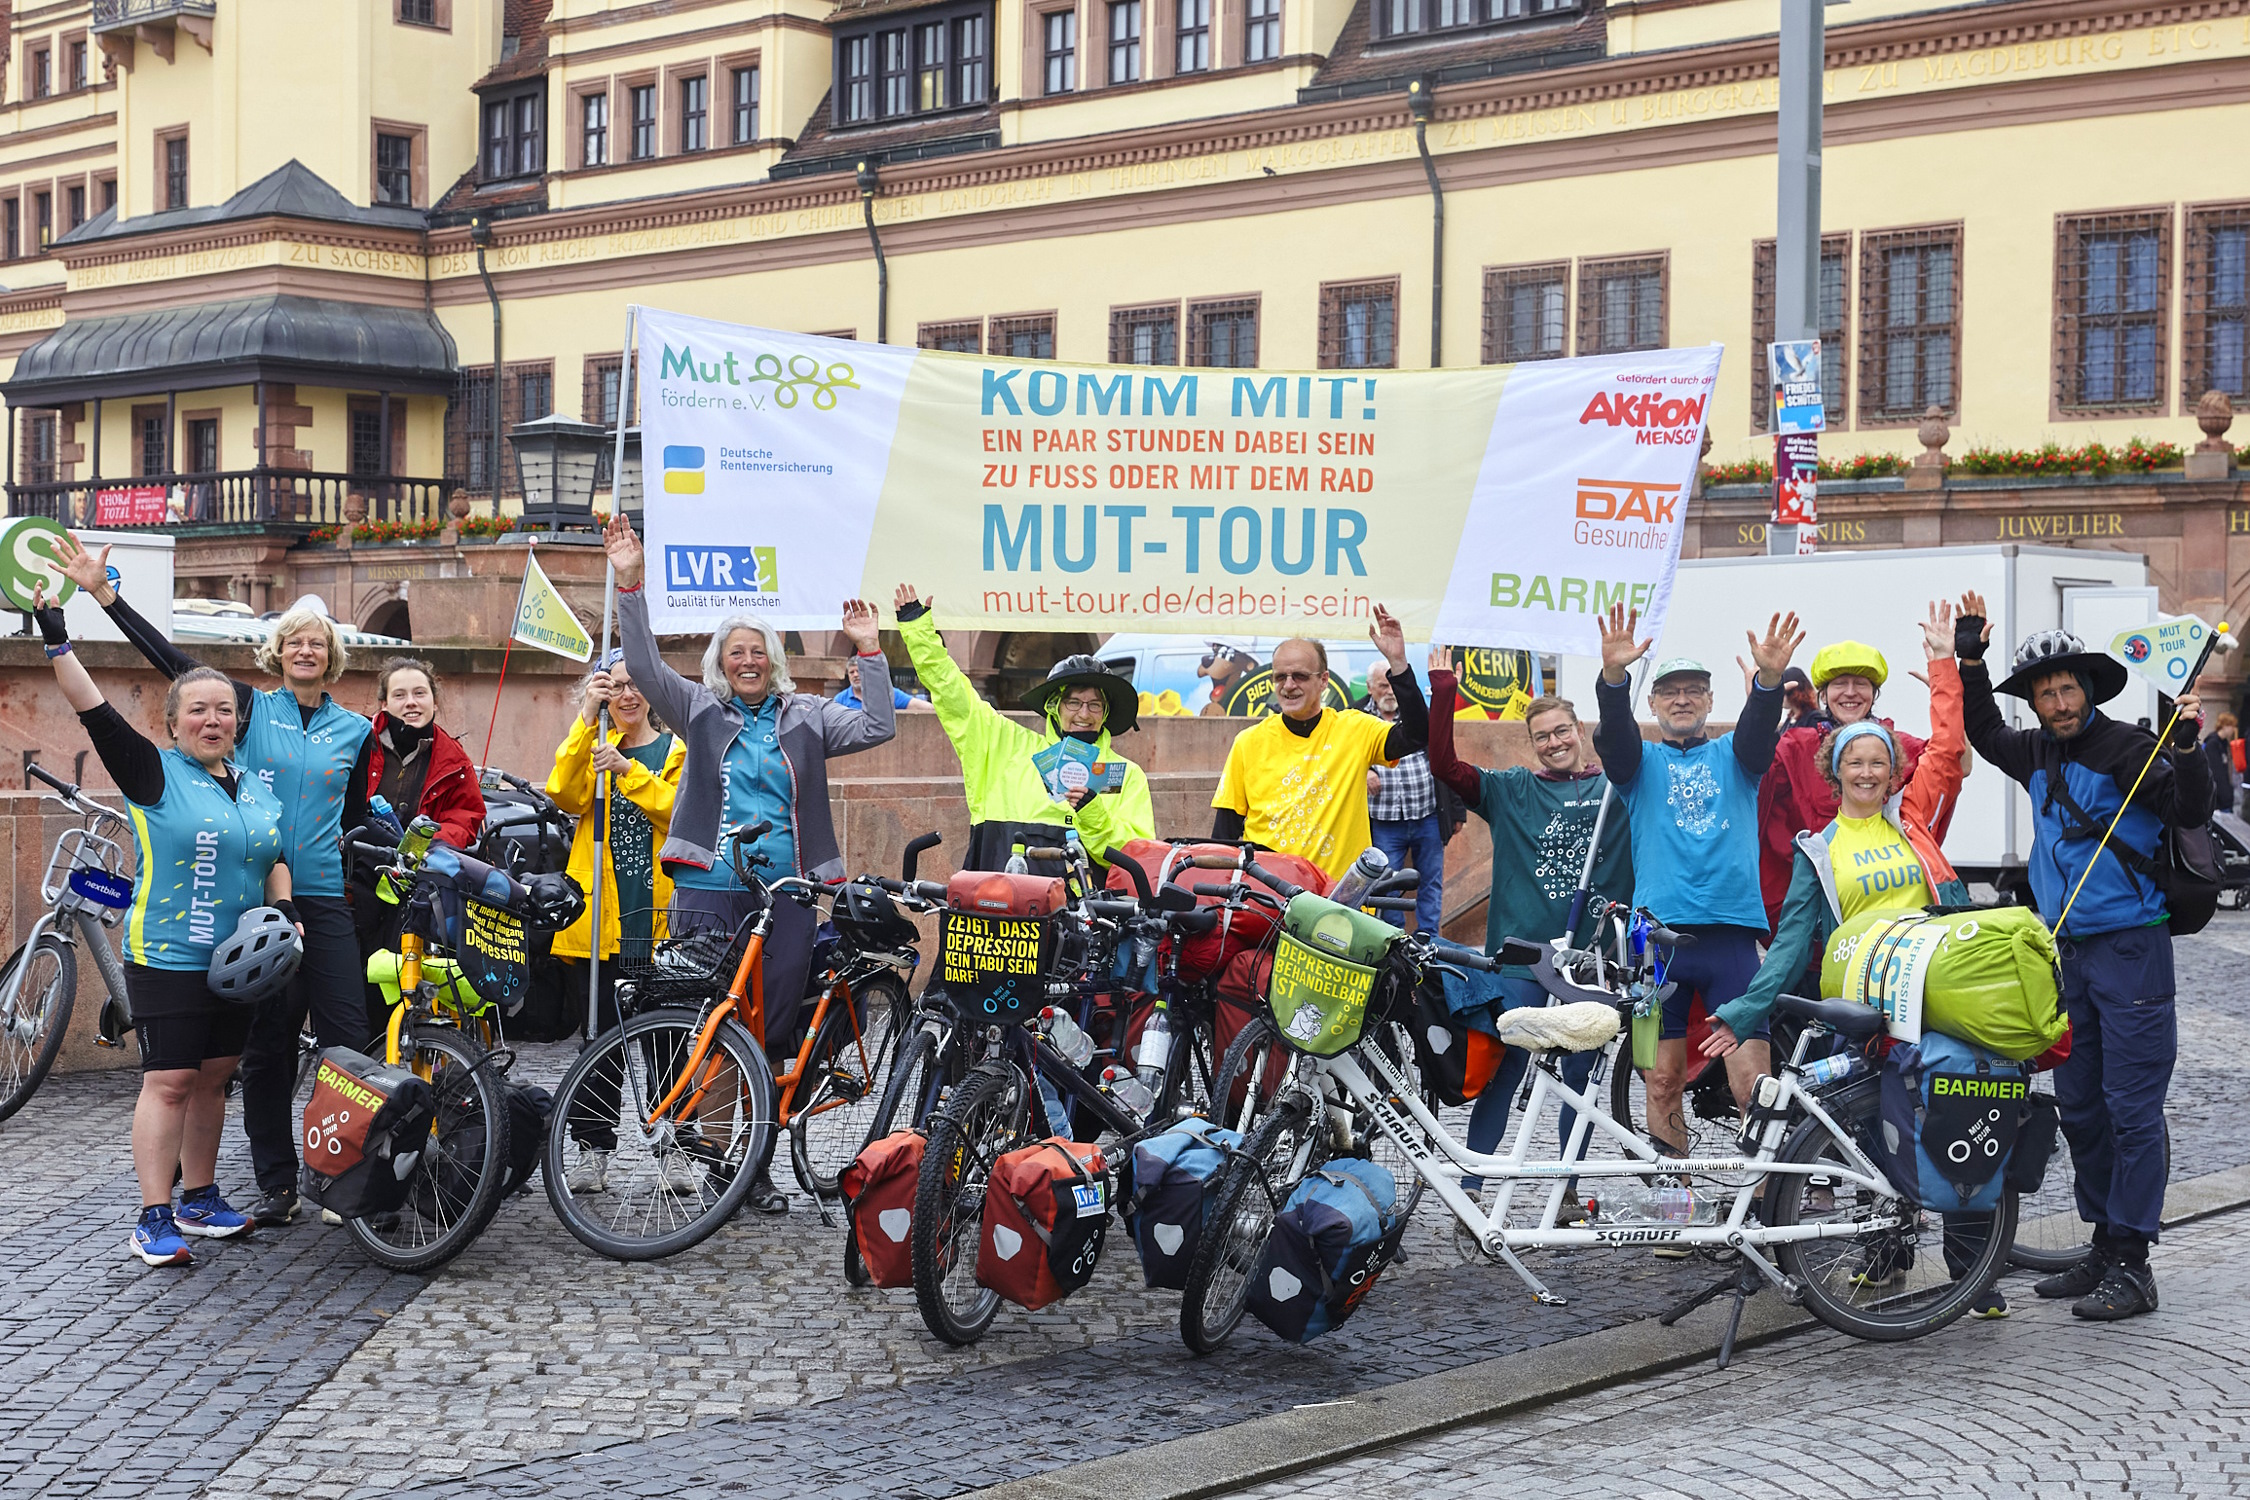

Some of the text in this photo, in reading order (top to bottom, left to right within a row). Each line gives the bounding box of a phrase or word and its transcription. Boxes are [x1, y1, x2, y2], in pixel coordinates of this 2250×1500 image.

[441, 254, 468, 275] DES
[540, 239, 597, 262] REICHS
[748, 217, 788, 237] UND
[938, 178, 1054, 213] LANDGRAFF
[1069, 173, 1091, 195] IN
[1244, 130, 1419, 173] MARGGRAFFEN
[1442, 121, 1477, 147] ZU
[1491, 105, 1597, 142] MEISSEN
[1858, 61, 1899, 92] ZU
[1922, 33, 2124, 84] MAGDEBURG
[2147, 24, 2220, 57] ETC.
[76, 266, 119, 288] HERRN
[290, 244, 320, 264] ZU
[330, 247, 419, 273] SACHSEN
[660, 342, 741, 386] Mut
[1616, 374, 1667, 385] Gefördert
[1670, 375, 1699, 385] durch
[661, 388, 727, 409] fördern
[980, 368, 1378, 420] KOMM MIT!
[981, 429, 1375, 457] EIN PAAR STUNDEN DABEI SEIN
[1635, 429, 1698, 445] MENSCH
[720, 447, 773, 460] Deutsche
[720, 460, 833, 476] Rentenversicherung
[982, 464, 1374, 493] ZU FUSS ODER MIT DEM RAD
[103, 507, 131, 519] TOTAL
[1576, 478, 1682, 524] DAK
[1737, 519, 1866, 545] SONIRS
[1996, 513, 2124, 540] JUWELIER
[983, 503, 1368, 577] MUT-TOUR
[13, 527, 65, 600] S
[368, 564, 425, 579] MEISSENER
[670, 551, 735, 586] LVR
[667, 595, 781, 608] Qualität für Menschen
[983, 585, 1371, 619] mut-tour.de/dabei-sein
[1490, 573, 1657, 618] BARME
[517, 619, 589, 655] WWW.MUT-TOUR.DE
[2159, 625, 2181, 638] MUT
[2159, 639, 2186, 653] TOUR
[1465, 647, 1518, 678] KERN
[1853, 843, 1904, 866] MUT
[85, 879, 122, 898] nextbike
[188, 831, 219, 945] MUT-TOUR
[1856, 864, 1921, 896] TOUR
[480, 904, 499, 919] mehr
[495, 922, 524, 940] Umgang
[947, 914, 1040, 939] ZEIGT, DASS
[466, 928, 526, 965] Depression
[494, 932, 519, 947] Thema
[946, 933, 1039, 959] DEPRESSION
[99, 943, 127, 999] nextbike
[945, 951, 1037, 975] KEIN TABU SEIN
[945, 967, 980, 984] DARF!
[1279, 940, 1371, 991] DEPRESSION
[993, 985, 1005, 997] MUT
[1274, 974, 1298, 999] IST
[1275, 959, 1366, 1007] BEHANDELBAR
[1868, 935, 1913, 1022] IST
[1899, 937, 1925, 1023] DEPRESSION
[998, 989, 1011, 1002] TOUR
[317, 1064, 384, 1113] BARMER
[1934, 1077, 2026, 1100] BARMER
[322, 1113, 335, 1127] MUT
[322, 1124, 338, 1138] TOUR
[1365, 1092, 1429, 1160] SCHAUFF
[1968, 1118, 1985, 1136] MUT
[1973, 1126, 1991, 1145] TOUR
[1656, 1162, 1746, 1172] www.mut-tour.de
[1077, 1188, 1094, 1205] LVR
[1596, 1230, 1682, 1242] SCHAUFF
[1366, 1250, 1376, 1265] MUT
